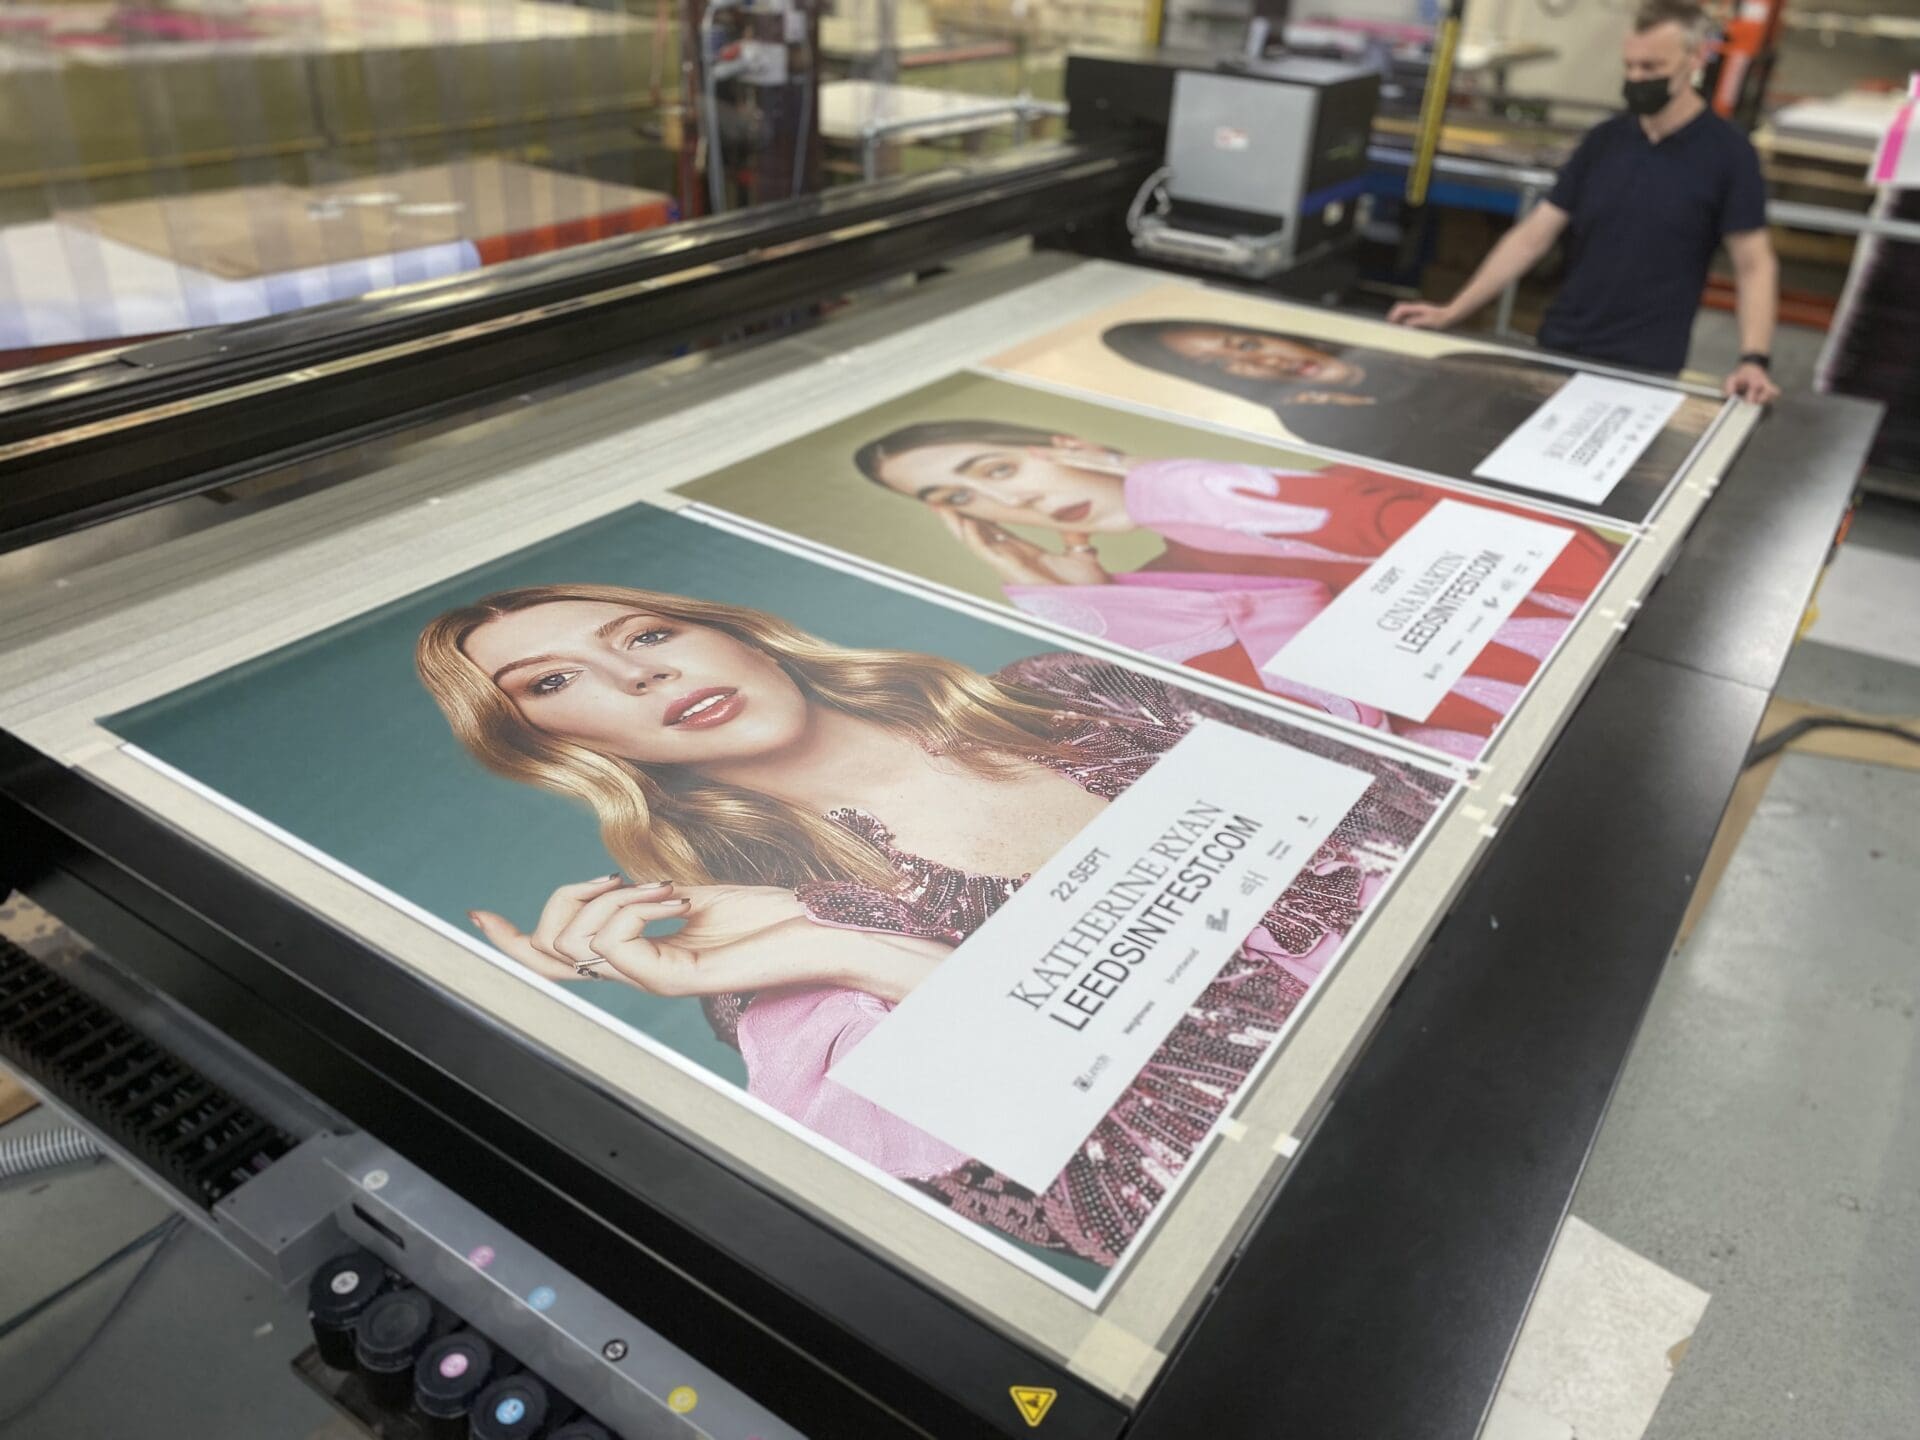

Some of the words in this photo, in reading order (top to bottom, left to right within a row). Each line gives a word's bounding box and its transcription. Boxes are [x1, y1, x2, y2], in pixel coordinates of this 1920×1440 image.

[1008, 856, 1169, 1011] KATHERINE
[1149, 800, 1223, 863] RYAN
[1050, 881, 1077, 902] 22
[1068, 847, 1111, 884] SEPT
[1050, 815, 1262, 1031] LEEDSINTFEST.COM
